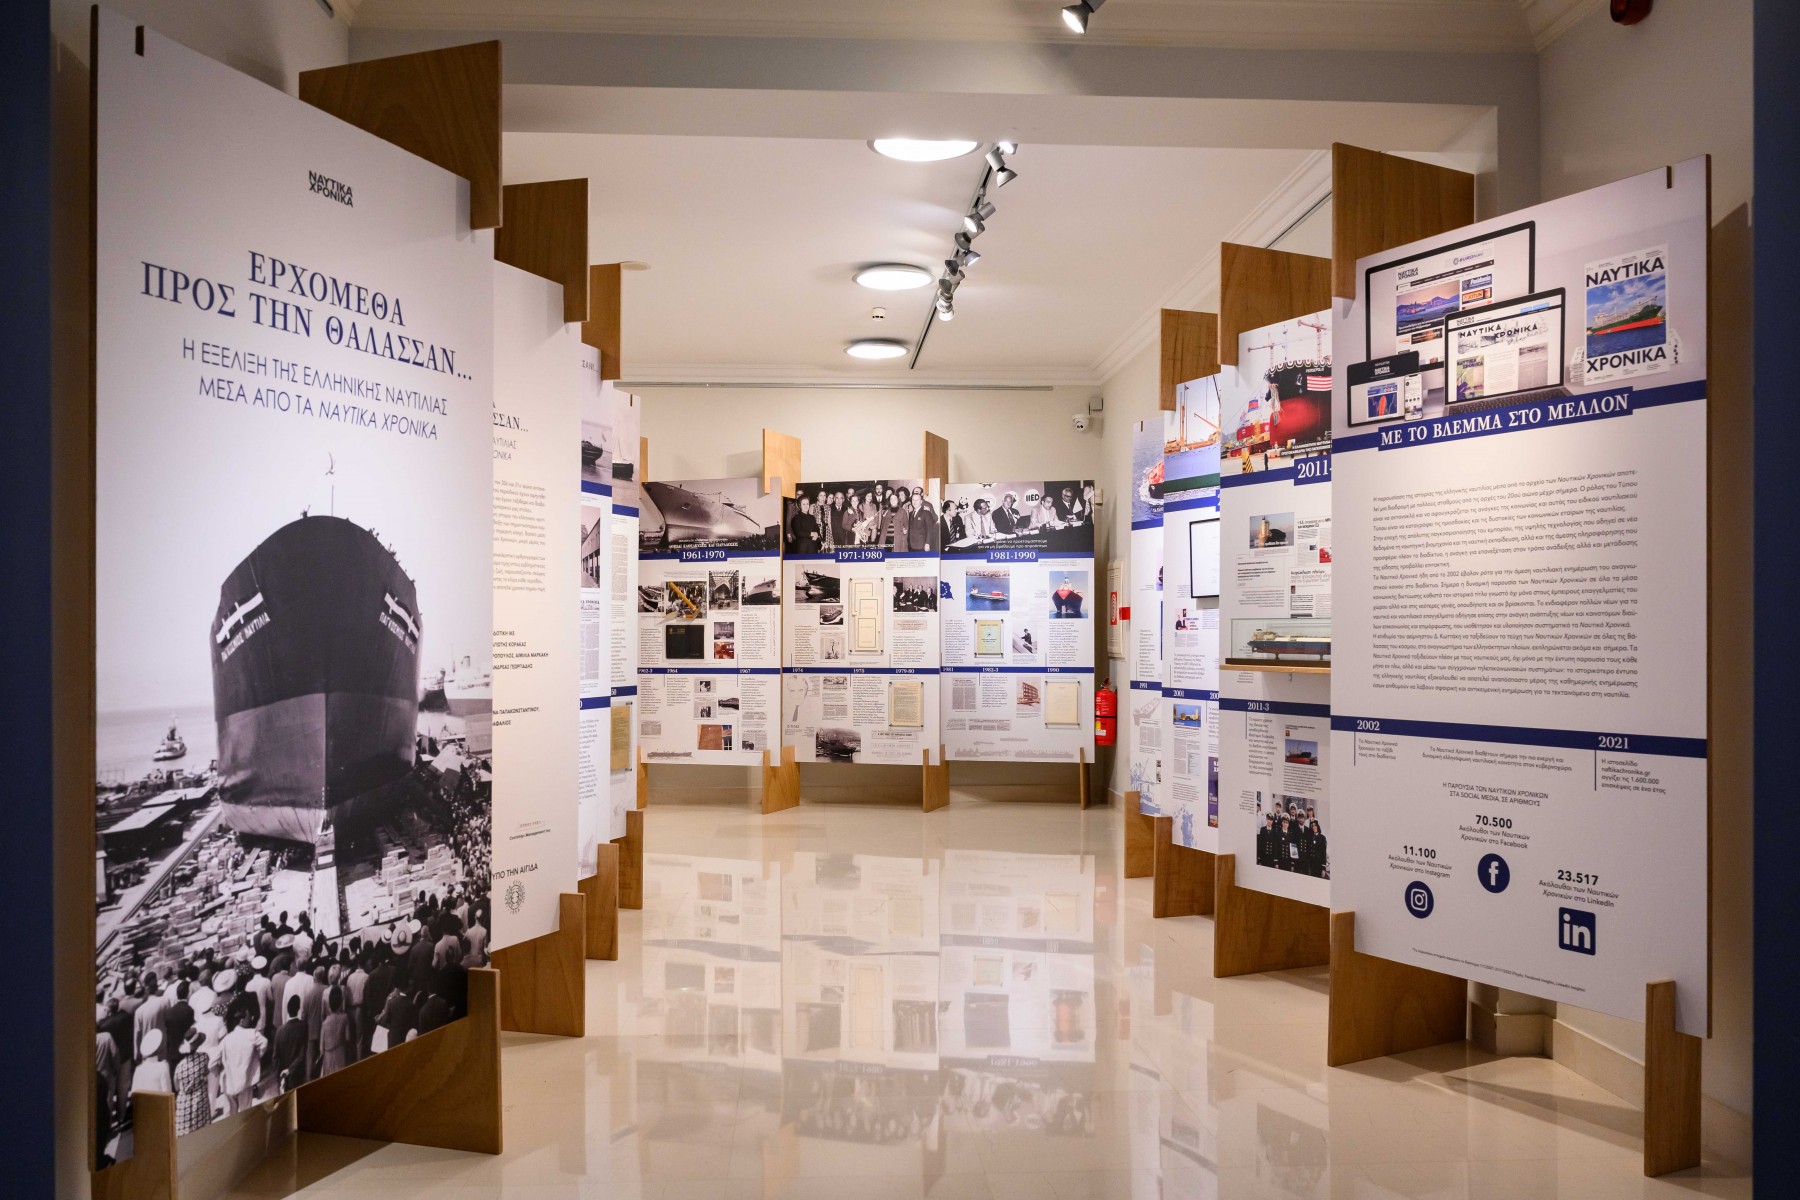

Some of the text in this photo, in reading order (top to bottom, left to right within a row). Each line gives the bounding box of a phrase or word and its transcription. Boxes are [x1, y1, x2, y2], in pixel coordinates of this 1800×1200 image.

[309, 170, 353, 196] ΝΑΥΤΙΚΑ
[309, 181, 353, 208] ΧΡΟΝΙΚΑ
[1586, 257, 1664, 288] ΝΑΥΤΙΚΑ
[248, 250, 406, 327] ΕΡΧΟΜΕΘΑ
[141, 261, 472, 381] ΠΡΟΣ ΤΗΝ ΘΑΛΑΣΣΑΝ...
[1459, 324, 1502, 338] ΝΑΥΤΙΚΑ
[1494, 324, 1538, 339] ΧΡΟΝΙΚΑ
[1586, 346, 1666, 373] ΧΡΟΝΙΚΑ
[182, 338, 448, 416] Η ΕΞΕΛΙΞΗ ΤΗΣ ΕΛΛΗΝΙΚΗΣ ΝΑΥΤΙΛΙΑΣ
[199, 377, 437, 440] ΜΕΣΑ ΑΠΟ ΤΑ ΝΑΥΤΙΚΑ ΧΡΟΝΙΚΑ
[1380, 394, 1629, 447] ΜΕ ΤΟ ΒΛΕΜΜΑ ΣΤΟ ΜΕΛΛΟΝ
[682, 550, 725, 560] 1961-1970
[838, 551, 883, 560] 1971-1980
[990, 551, 1036, 560] 1981-1990
[1247, 702, 1270, 711] 2011-3
[1356, 719, 1380, 731] 2002
[1598, 735, 1629, 749] 2021
[1448, 783, 1474, 791] ΠΑΡΟΥΣΙΑ
[1488, 787, 1516, 795] ΝΑΥΤΙΚΩΝ
[1517, 790, 1548, 799] ΧΡΟΝΙΚΩΝ
[1461, 791, 1480, 800] SOCIAL
[1475, 814, 1512, 829] 70.500
[1460, 834, 1487, 843] Χρονικών
[1500, 839, 1528, 849] Facebook
[1502, 831, 1530, 840] Ναυτικών
[1403, 845, 1436, 859] 11.100
[506, 868, 519, 878] ΤΗΝ
[1425, 868, 1450, 879] Instagram
[1557, 869, 1598, 885] 23.517
[1539, 880, 1572, 891] Ακόλουθοι
[1587, 888, 1619, 899] Ναυτικών
[1542, 889, 1573, 900] Χρονικών
[1587, 897, 1614, 907] LinkedIn
[1563, 913, 1591, 949] in
